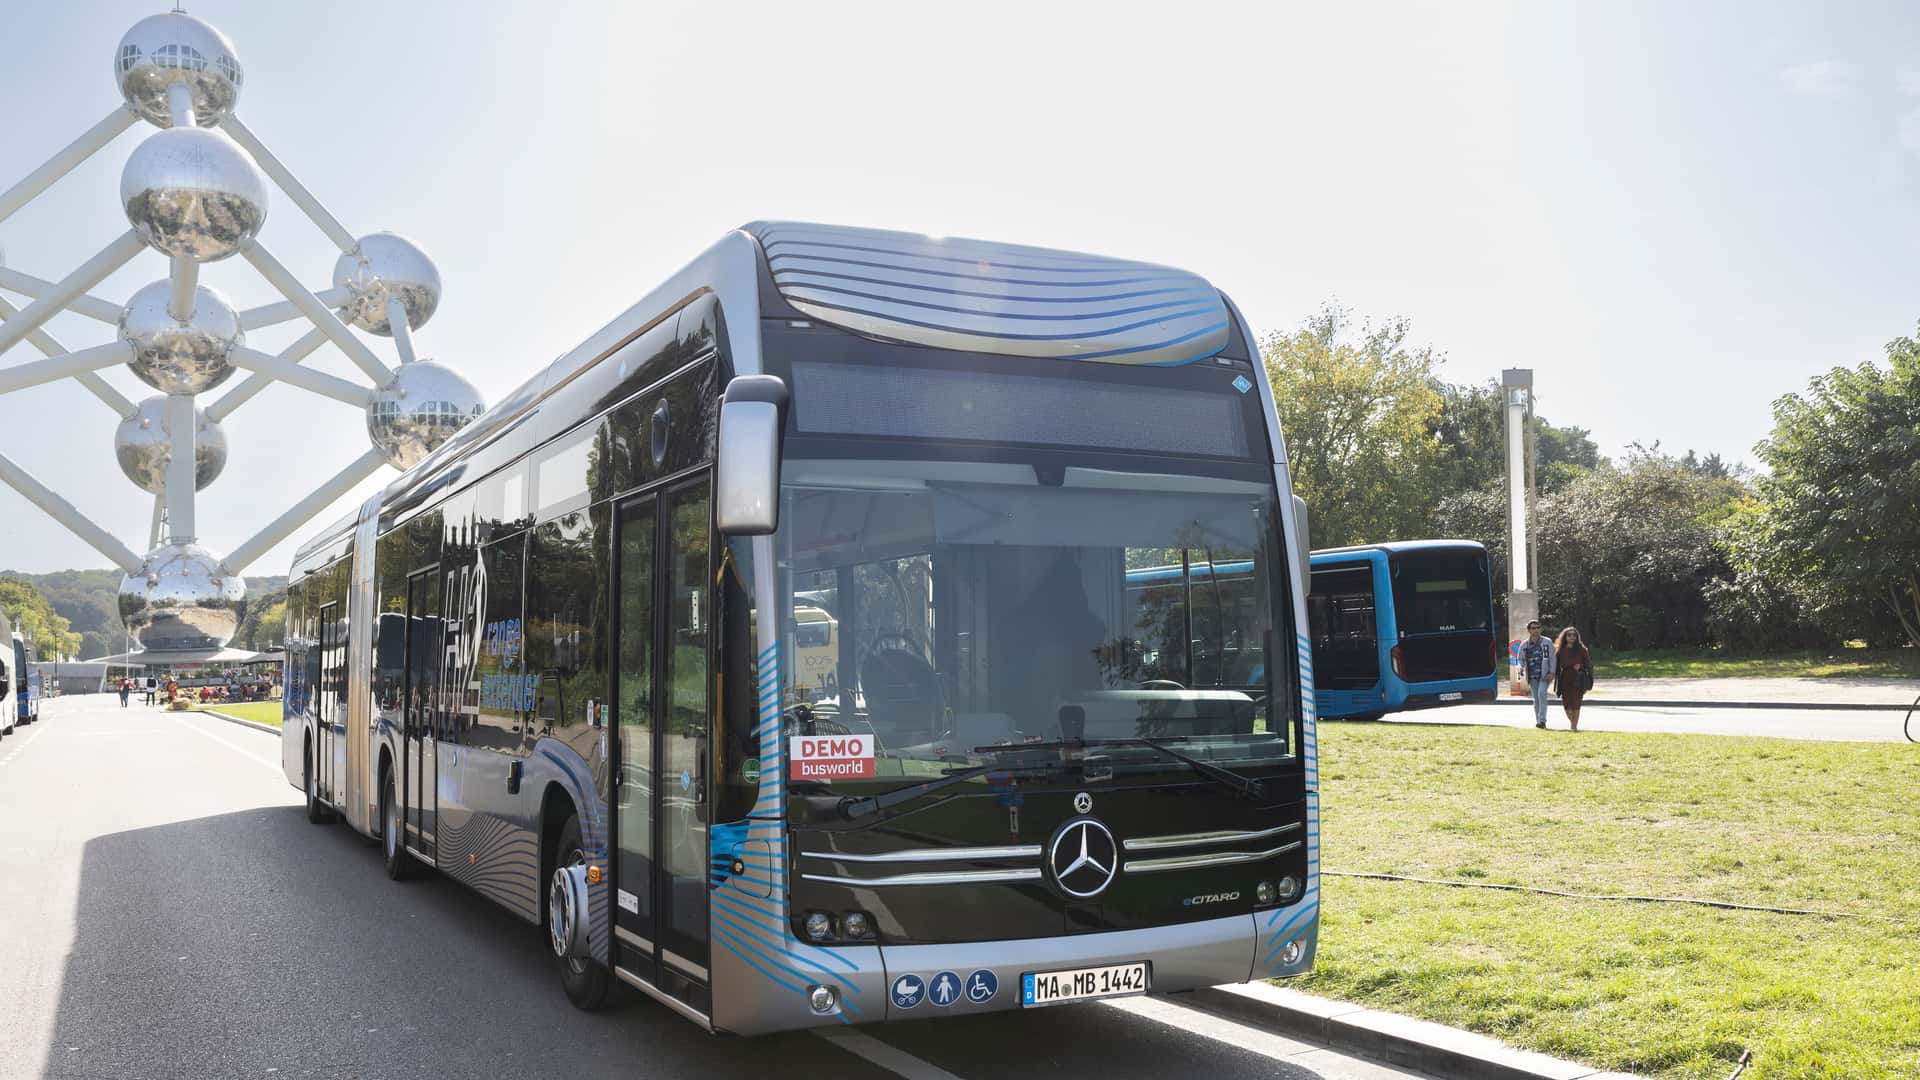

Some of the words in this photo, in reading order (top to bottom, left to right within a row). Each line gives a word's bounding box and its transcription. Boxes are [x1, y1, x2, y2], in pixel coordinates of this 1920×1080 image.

[486, 617, 521, 668] range
[482, 665, 539, 712] extender
[801, 739, 863, 758] DEMO
[802, 760, 863, 775] busworld
[1036, 976, 1060, 999] MA
[1073, 972, 1096, 995] MB
[1100, 967, 1143, 992] 1442
